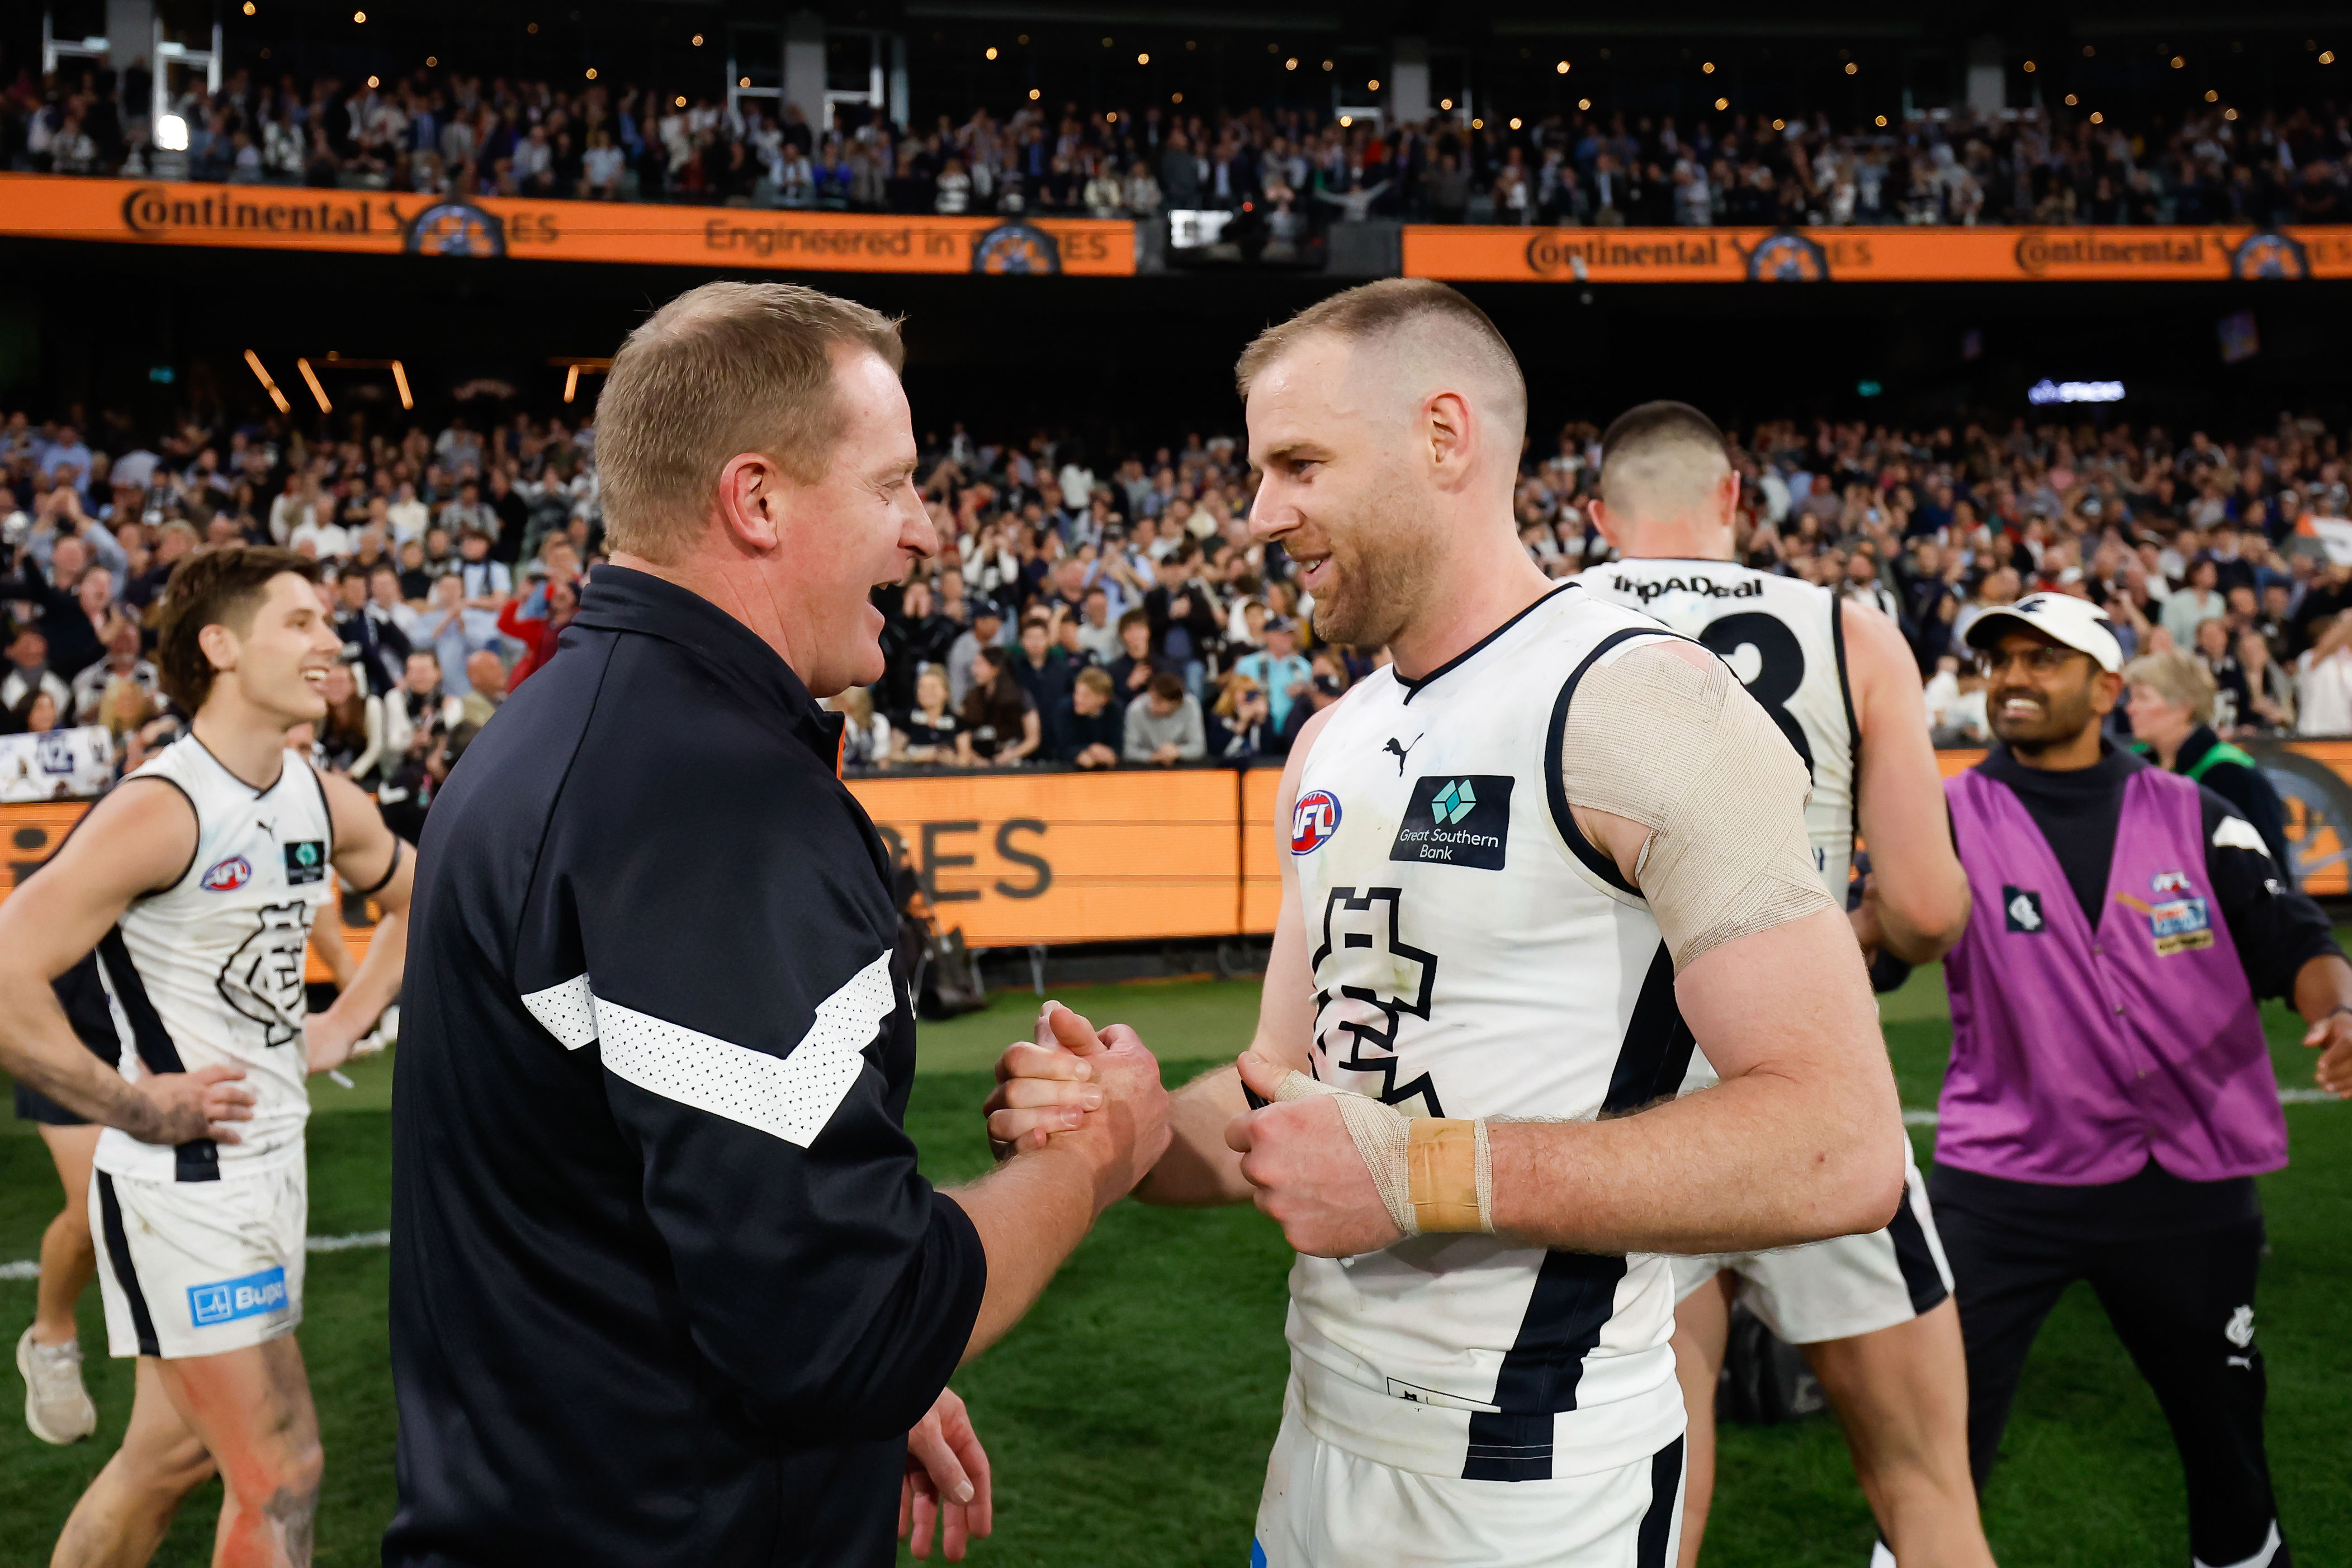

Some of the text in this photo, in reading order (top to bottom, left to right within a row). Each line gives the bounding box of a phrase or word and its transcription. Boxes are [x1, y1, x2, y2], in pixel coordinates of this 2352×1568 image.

[121, 187, 371, 235] Continental
[705, 219, 957, 257] Engineered in
[1524, 231, 1719, 274] Continental
[1696, 612, 1815, 787] 3
[1400, 828, 1499, 848] Great Southern
[1419, 844, 1454, 860] Bank
